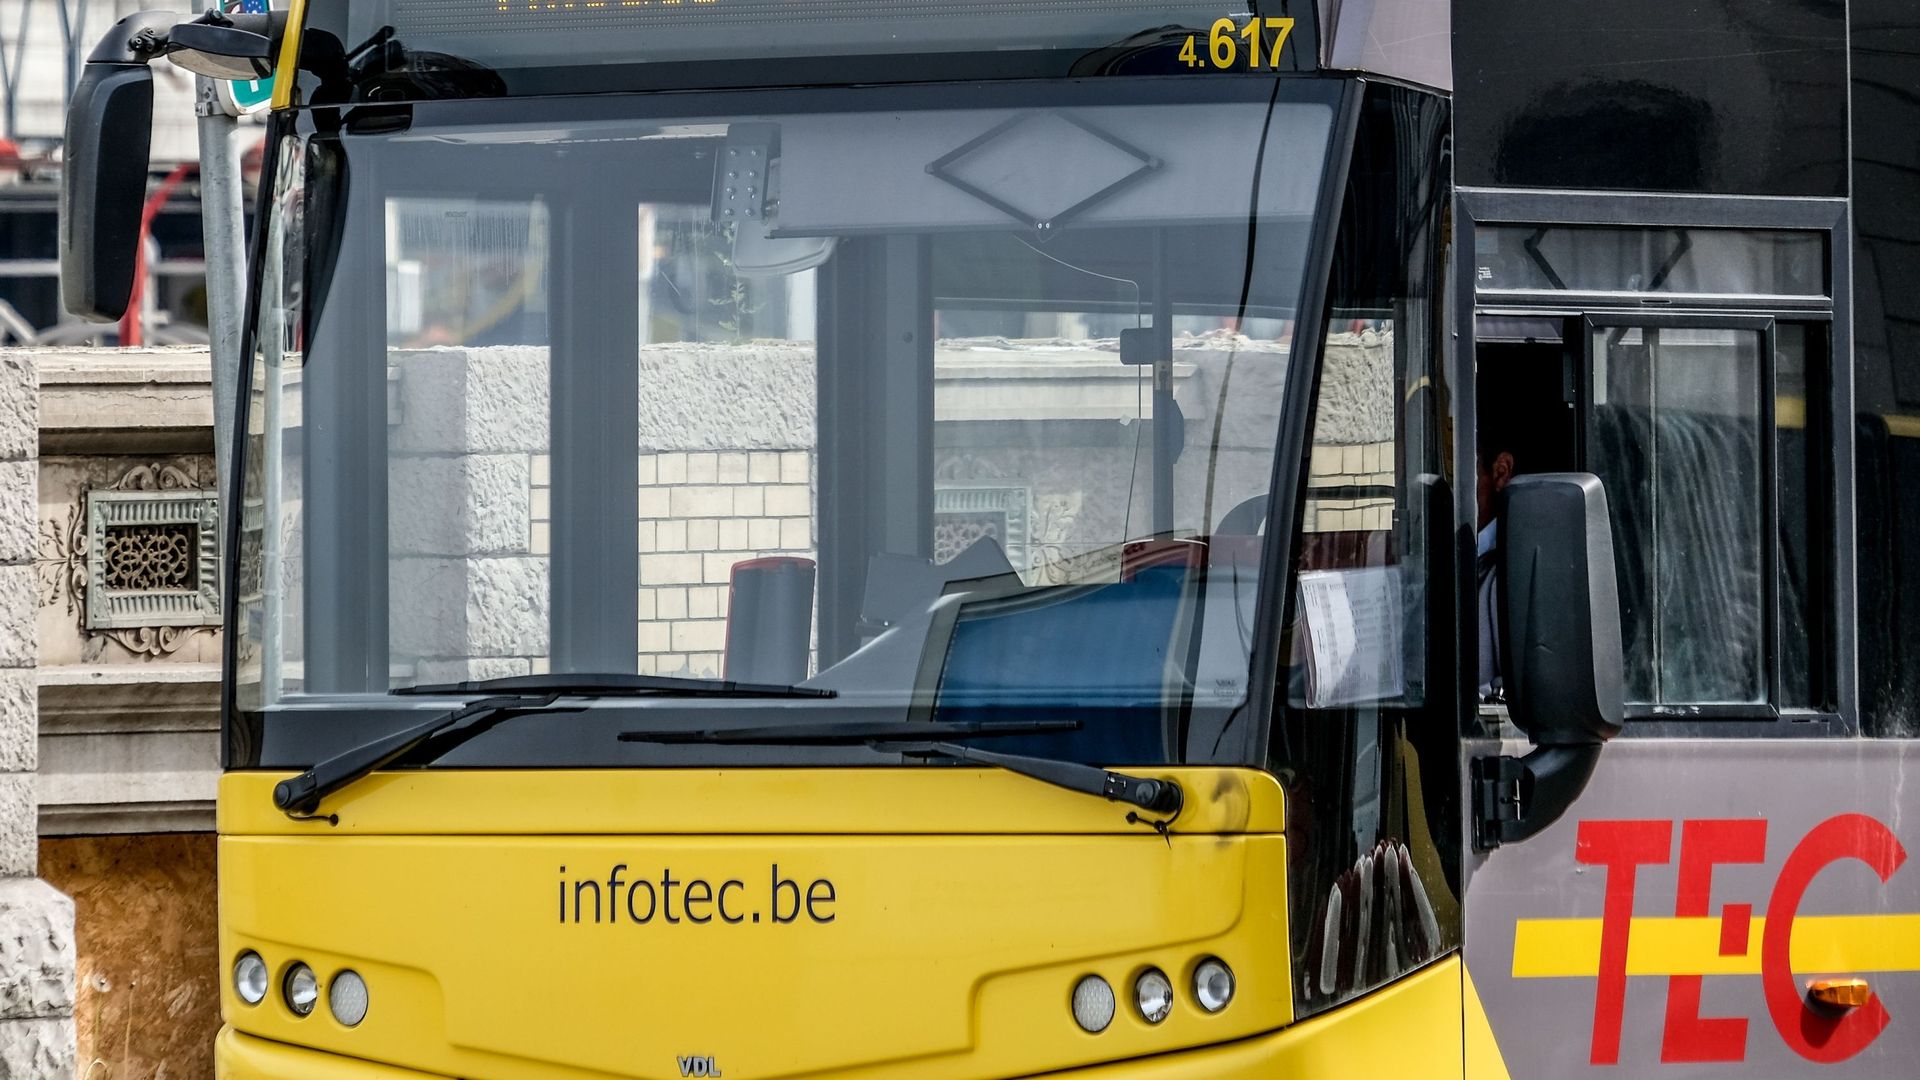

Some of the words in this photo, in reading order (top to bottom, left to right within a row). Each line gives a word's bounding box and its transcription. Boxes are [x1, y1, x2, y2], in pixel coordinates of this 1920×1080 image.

[1178, 17, 1295, 69] 4.617
[559, 863, 836, 924] infotec.be
[1575, 813, 1908, 1065] TEC
[676, 1056, 722, 1077] VDL
